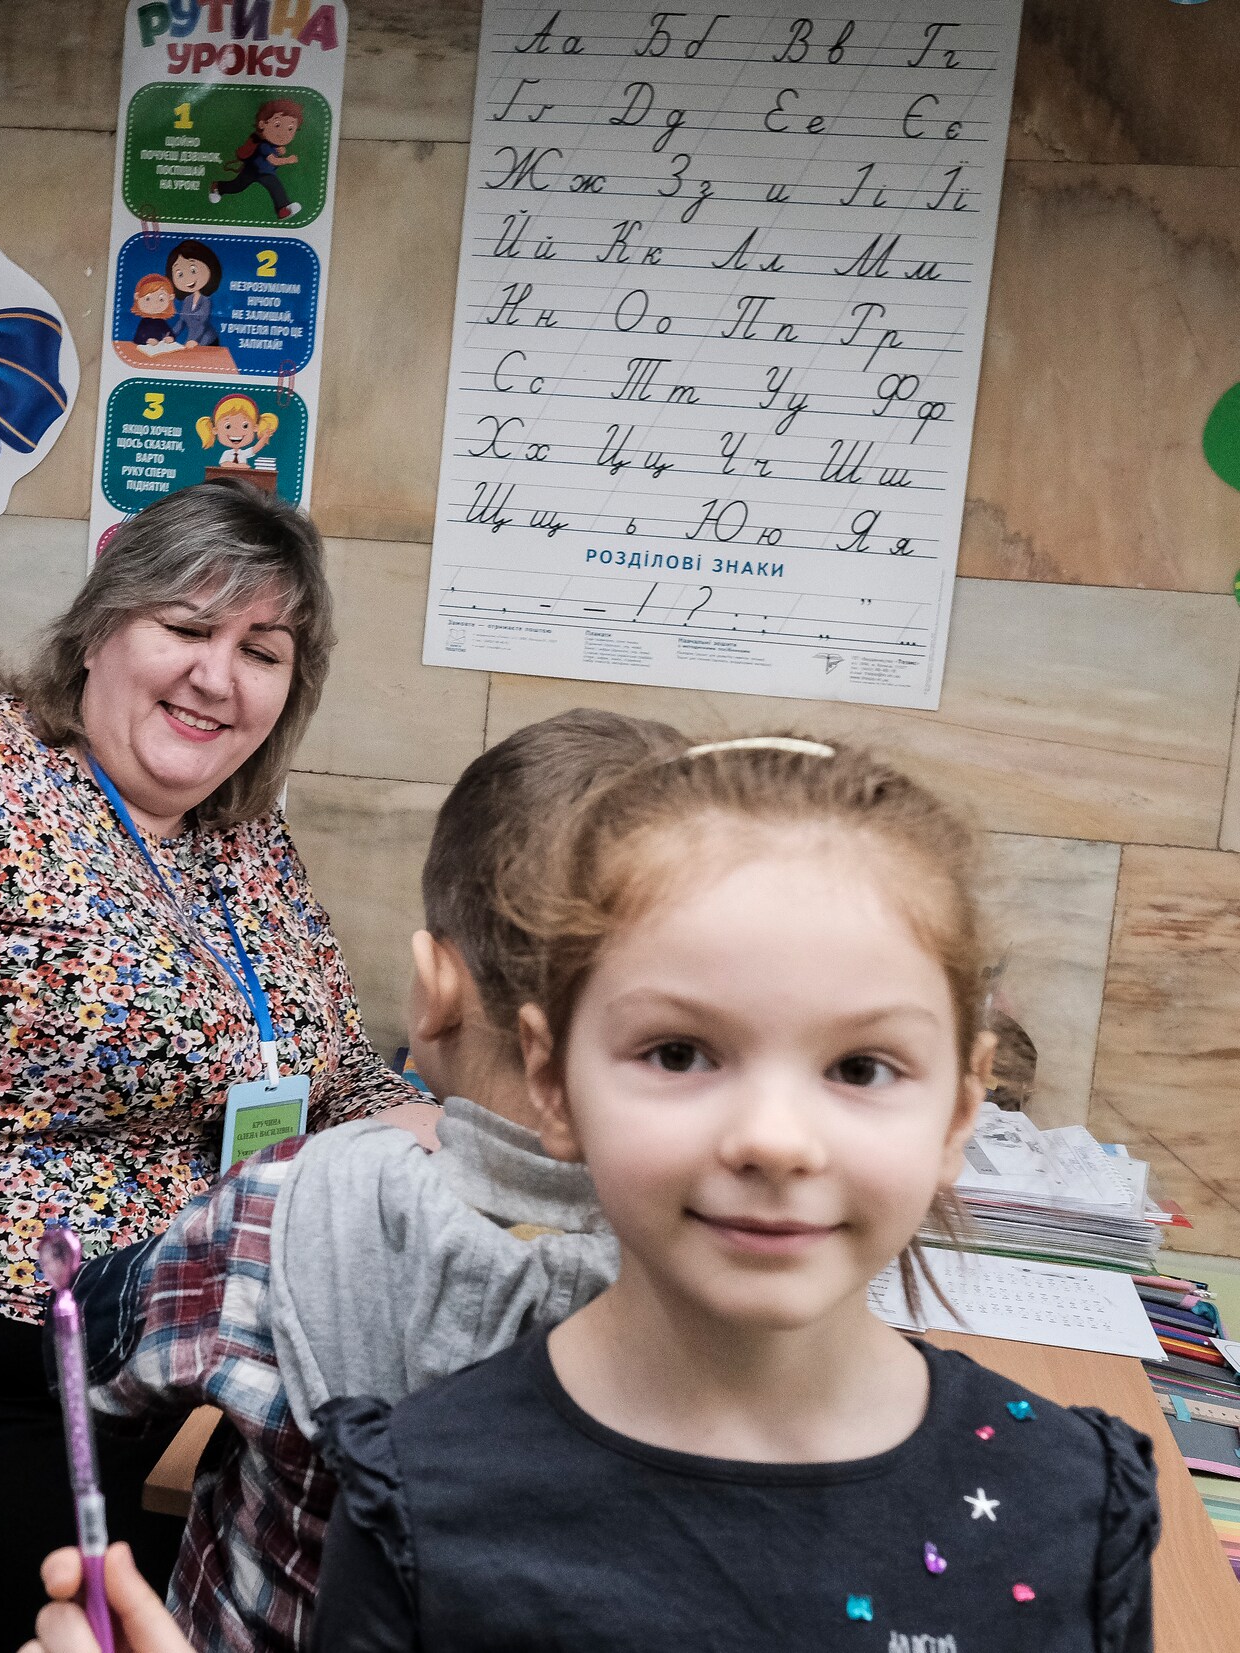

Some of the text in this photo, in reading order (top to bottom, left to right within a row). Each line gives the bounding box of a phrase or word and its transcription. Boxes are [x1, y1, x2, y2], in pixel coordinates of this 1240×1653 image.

[137, 0, 339, 51] РУТИНА
[167, 42, 302, 78] УРОКУ
[173, 102, 194, 129] 1
[165, 135, 200, 148] ЩОЙНО
[140, 150, 223, 164] ПОЧУЄШ ДЗВІНОК,
[156, 165, 206, 176] ПОСПІШАЙ
[160, 179, 173, 189] НА
[256, 250, 278, 277] 2
[229, 281, 301, 294] НЕЗРОЗУМІЛИМ
[247, 296, 281, 307] НІЧОГО
[231, 309, 294, 323] НЕ ЗАЛИШАЙ,
[220, 323, 303, 338] У ВЧИТЕЛЯ ПРО ЦЕ
[238, 338, 283, 350] ЗАПИТАЙ!
[142, 392, 165, 420] 3
[122, 424, 182, 437] ЯКЩО ХОЧЕШ
[117, 438, 185, 452] ЩОСЬ СКАЗАТИ,
[136, 453, 165, 464] ВАРТО
[122, 466, 176, 478] РУКУ СПЕРШ
[126, 480, 170, 492] ПІДНЯТИ!
[712, 558, 784, 577] ЗНАКИ
